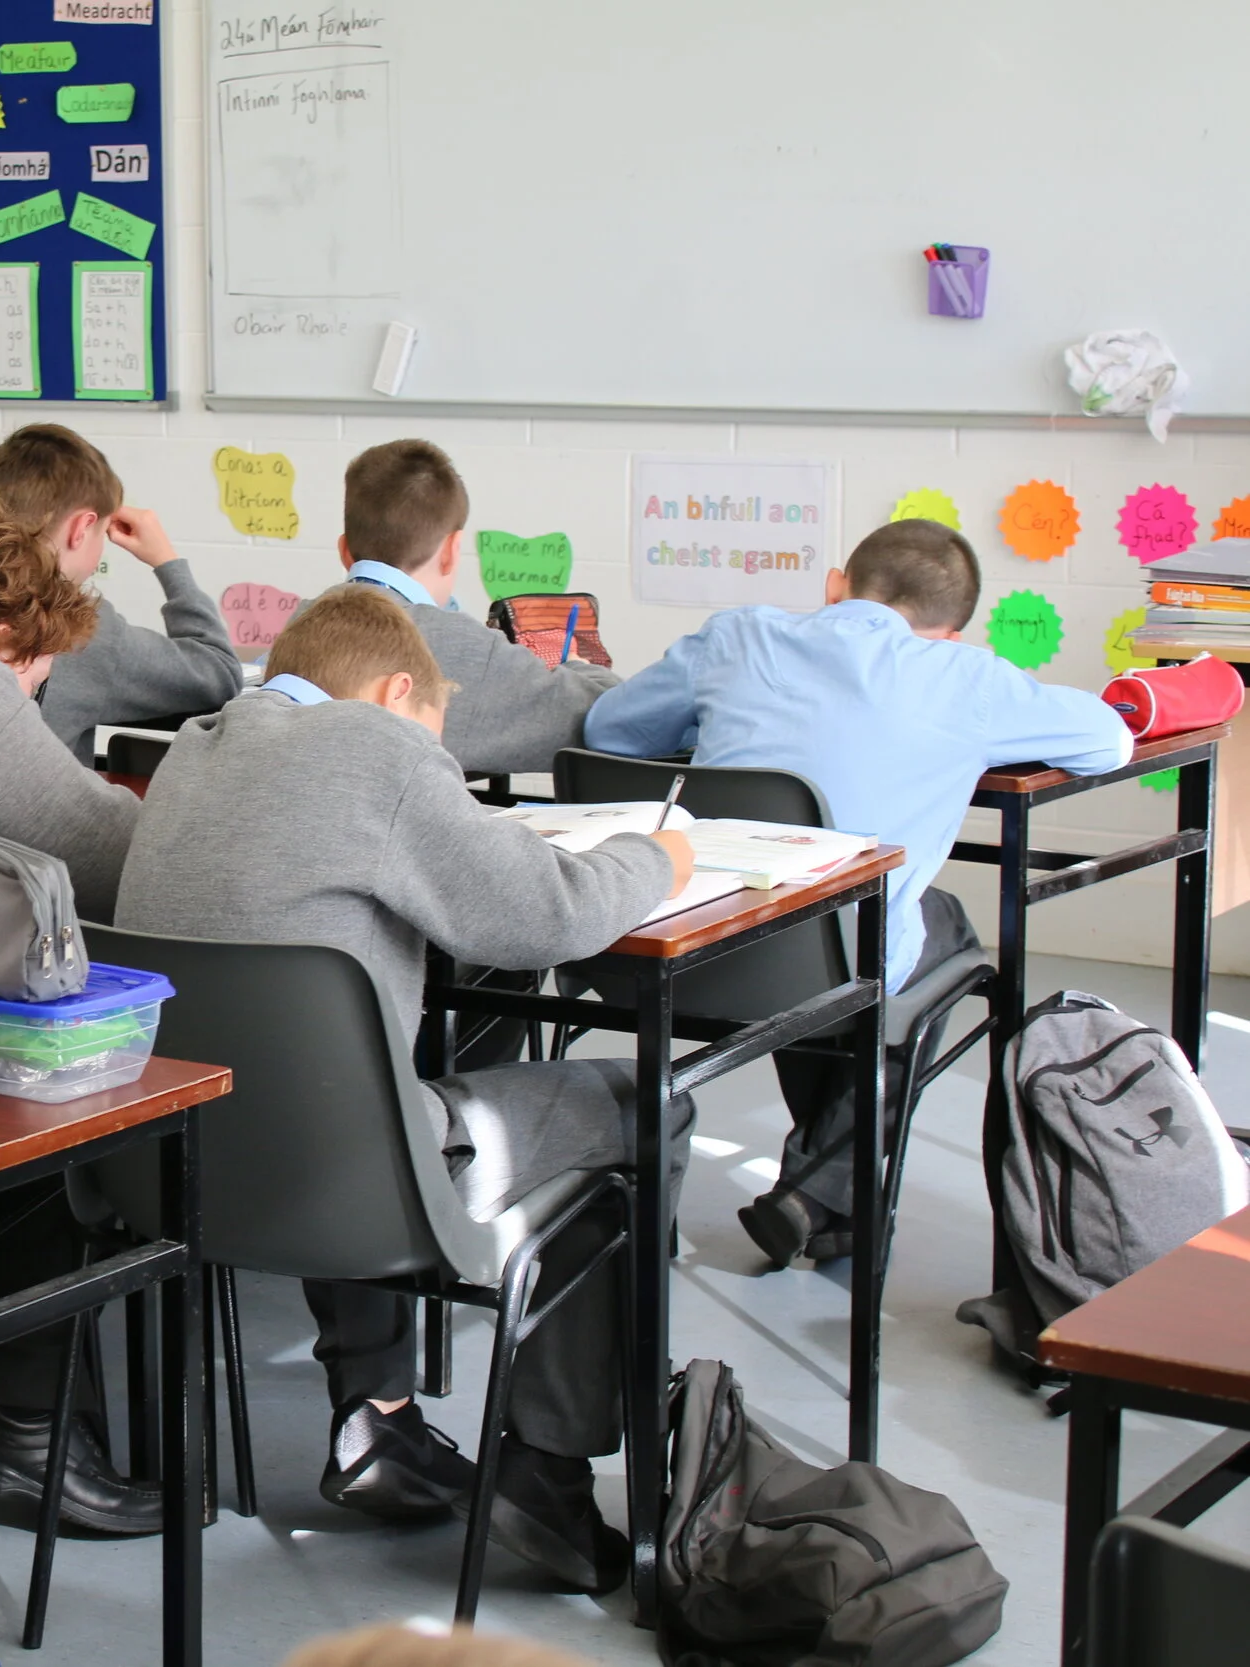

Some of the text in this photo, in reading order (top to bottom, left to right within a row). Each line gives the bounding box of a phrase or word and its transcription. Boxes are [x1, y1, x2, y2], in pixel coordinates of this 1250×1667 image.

[66, 2, 151, 20] Meadracht
[96, 148, 141, 173] Dán
[215, 447, 287, 476] Conas a
[644, 495, 818, 524] An bhfuil aon
[1136, 501, 1165, 522] Cá
[1225, 518, 1250, 538] Mín
[542, 535, 567, 559] mé
[647, 541, 815, 575] cheist agam?
[484, 560, 564, 587] dearmad
[222, 584, 253, 611] Cad
[258, 589, 267, 611] é
